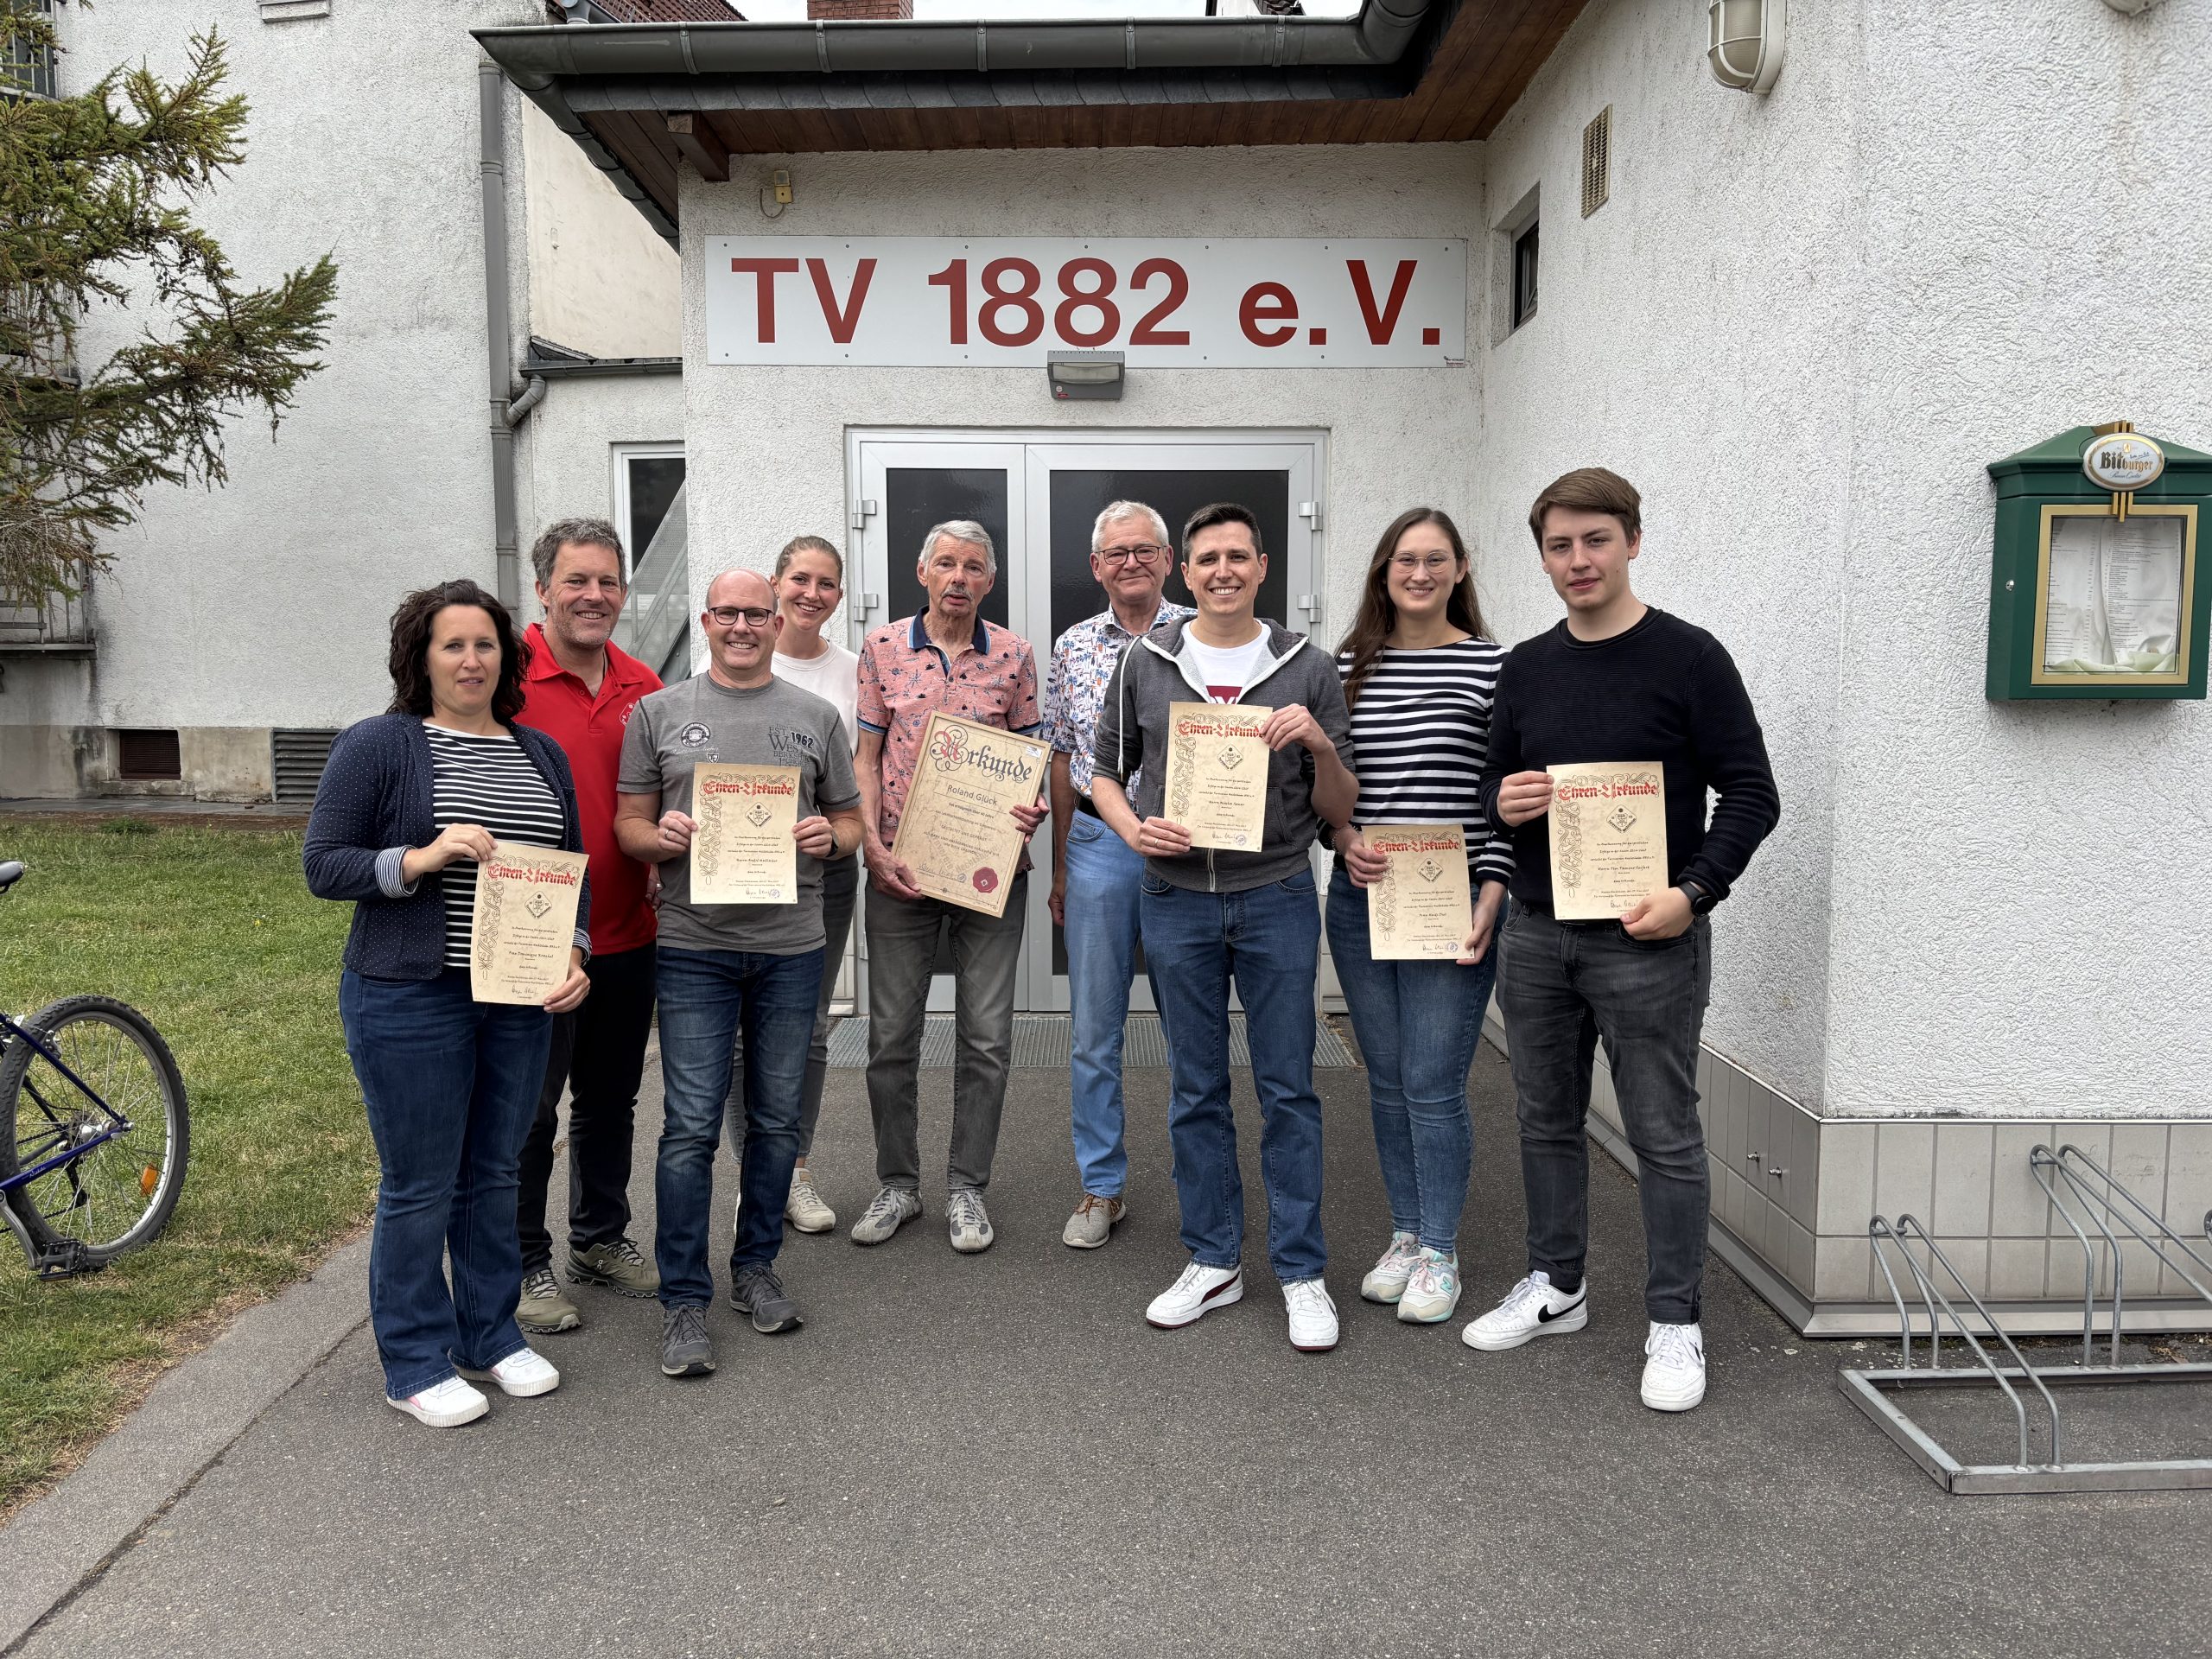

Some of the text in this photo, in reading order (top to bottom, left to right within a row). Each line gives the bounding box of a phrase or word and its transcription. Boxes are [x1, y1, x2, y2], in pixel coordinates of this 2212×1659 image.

[731, 257, 1440, 346] TV 1882 e.V.
[2100, 451, 2153, 473] Bitburger
[791, 731, 813, 749] 1962
[947, 785, 997, 805] Roland Glück
